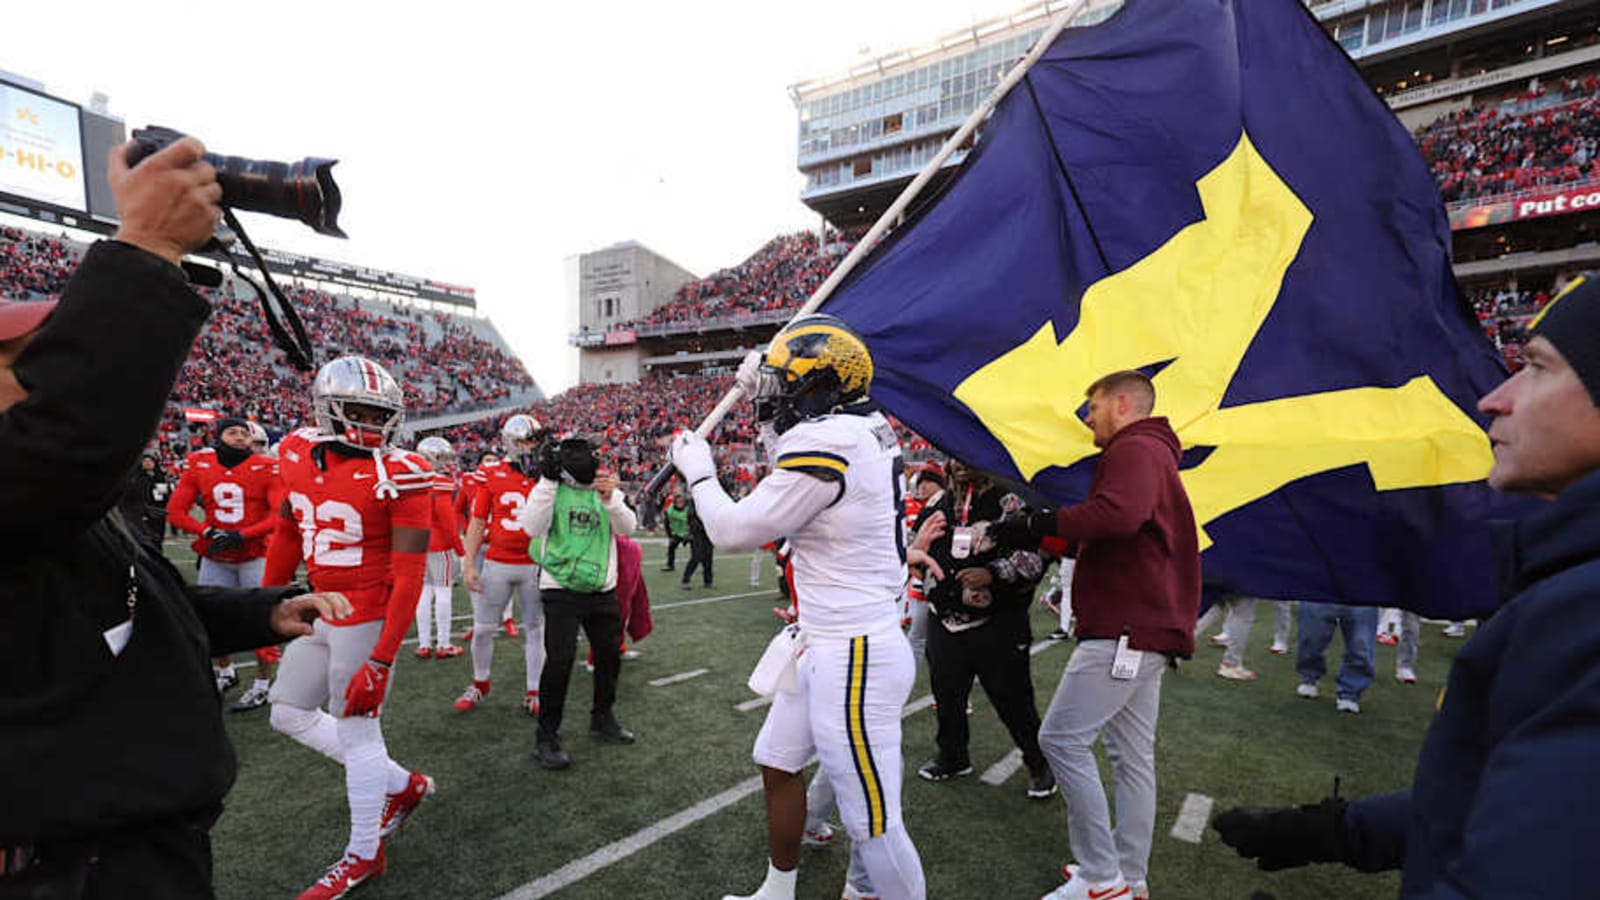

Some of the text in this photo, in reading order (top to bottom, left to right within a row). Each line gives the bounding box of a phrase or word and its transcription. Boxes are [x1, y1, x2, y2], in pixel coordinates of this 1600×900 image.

[1519, 195, 1567, 217] Put
[213, 482, 244, 524] 9
[500, 491, 528, 531] 3
